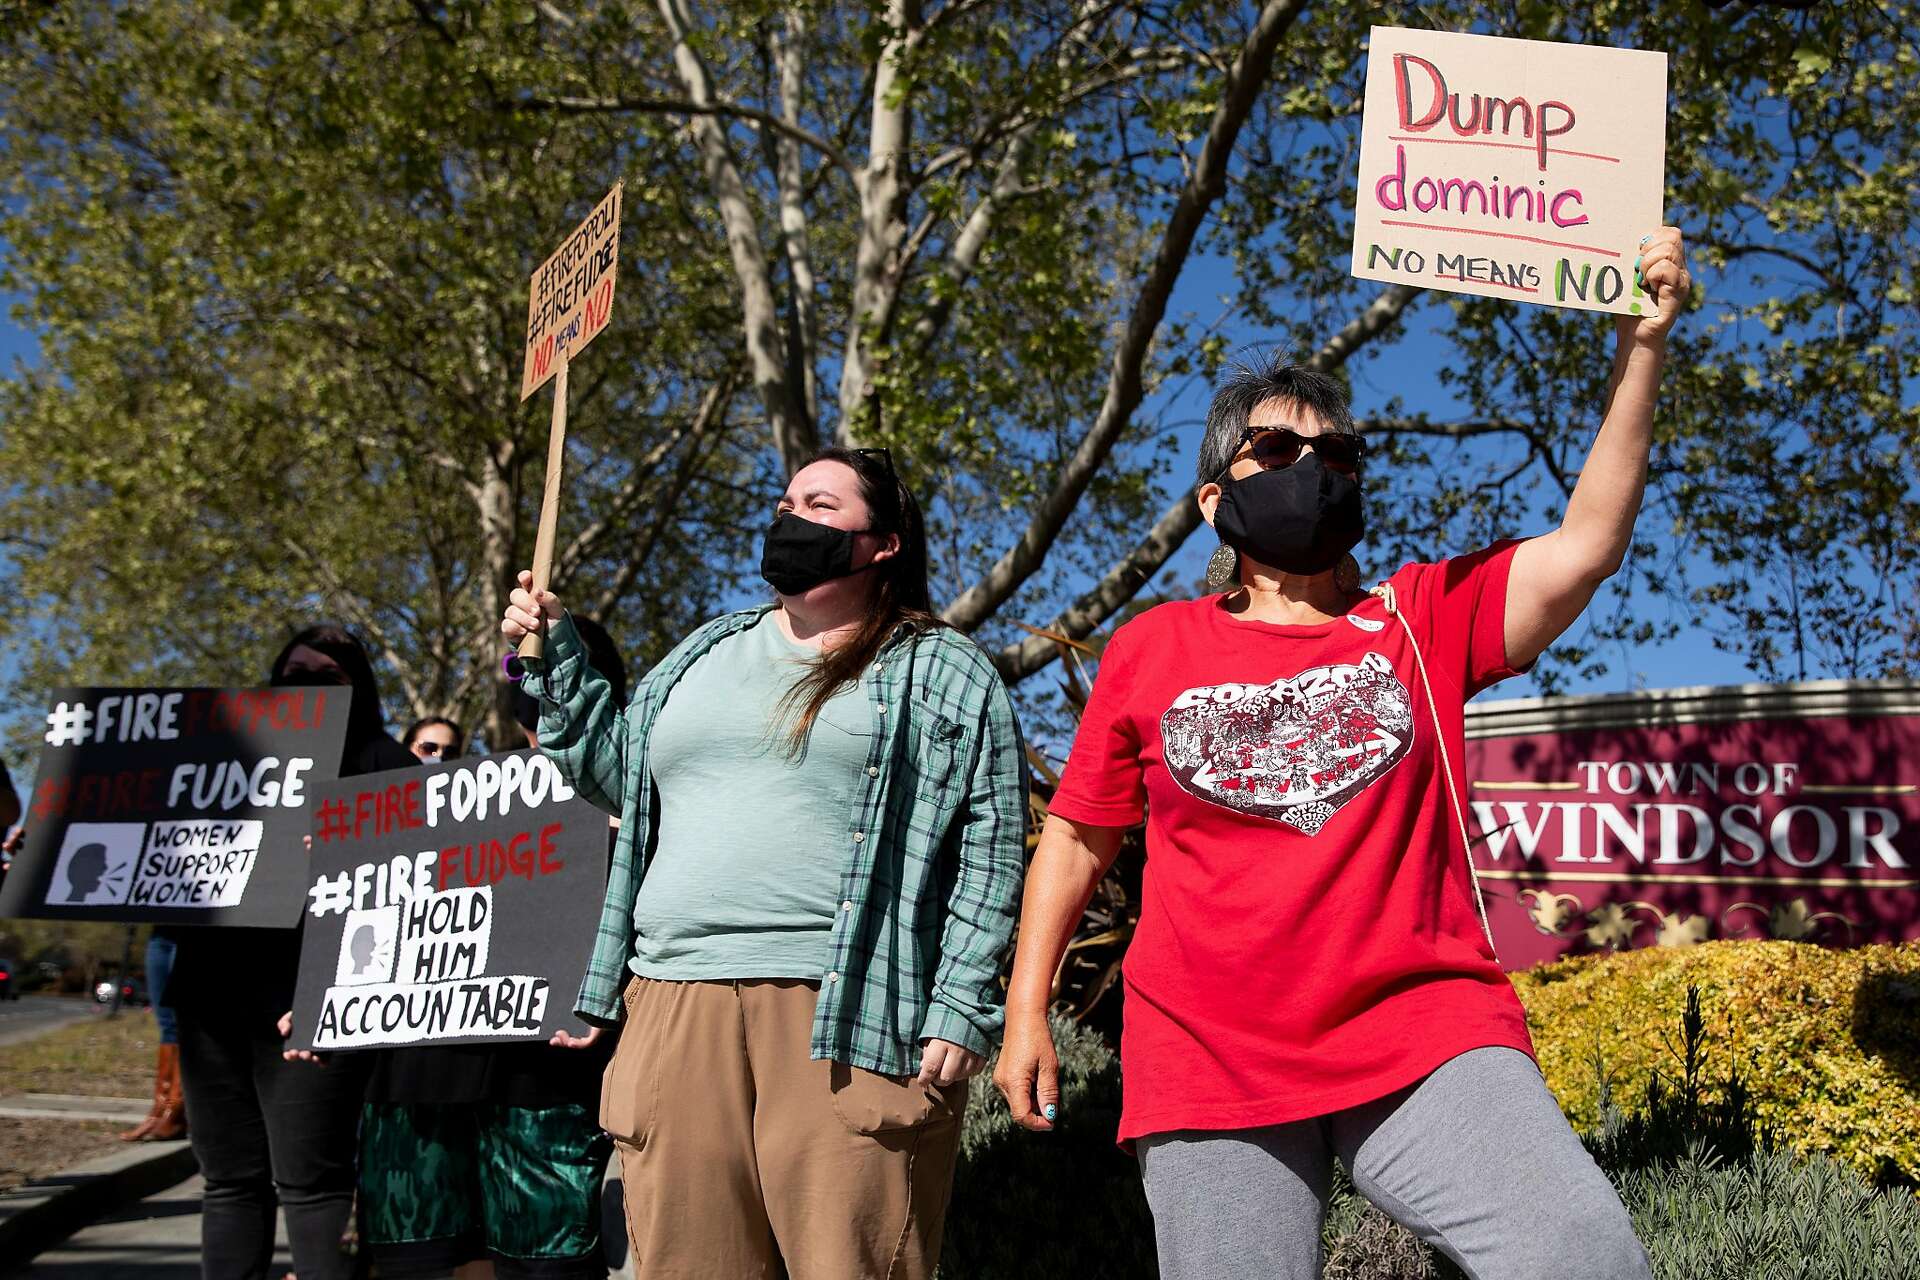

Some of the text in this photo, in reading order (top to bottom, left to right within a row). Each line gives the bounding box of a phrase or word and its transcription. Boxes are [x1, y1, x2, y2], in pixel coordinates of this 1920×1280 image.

[1393, 53, 1576, 171] Dump
[1376, 144, 1589, 228] dominic
[1368, 244, 1425, 273] NO
[1437, 254, 1540, 287] MEANS
[531, 279, 612, 384] NO MEANS NO
[45, 693, 184, 747] #FIRE
[167, 756, 313, 811] FUDGE
[315, 754, 576, 843] #FIRE FOPPOL
[1578, 761, 1800, 797] TOWN OF
[152, 824, 243, 848] WOMEN
[1468, 800, 1910, 869] WINDSOR
[145, 848, 255, 880] SUPPORT
[308, 822, 566, 918] #FIRE FUDGE
[134, 879, 228, 904] WOMEN
[407, 891, 488, 941] HOLD
[415, 942, 477, 982] HIM
[318, 977, 550, 1043] ACCOUNTABLE
